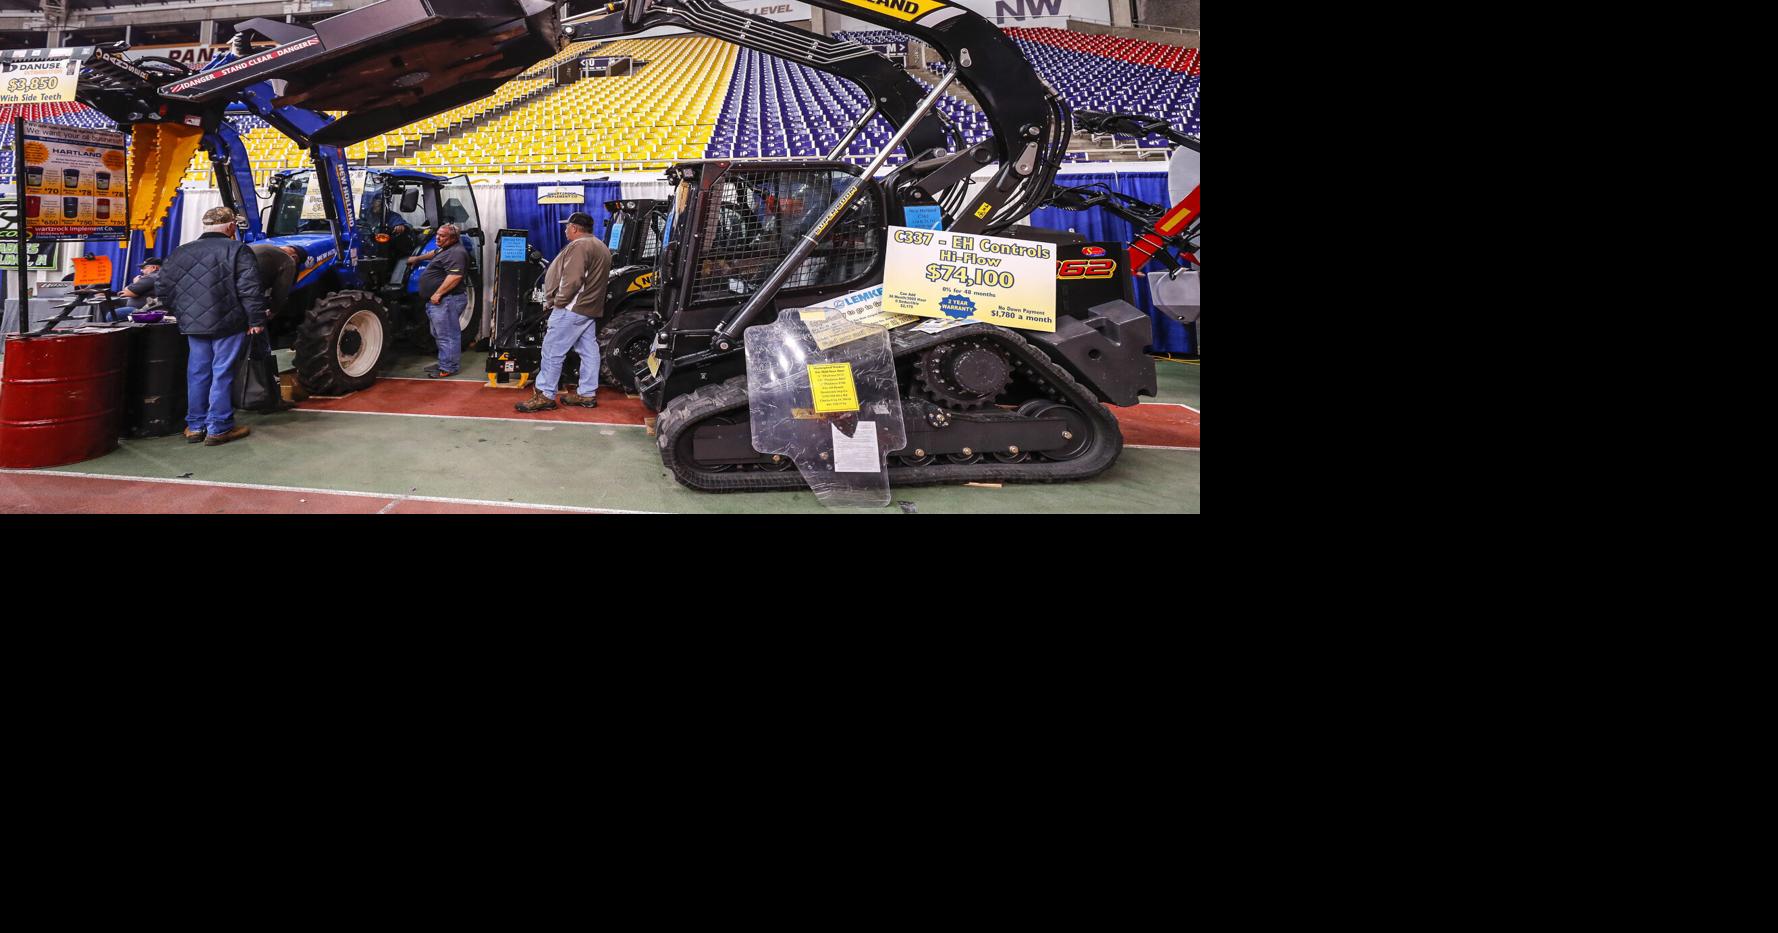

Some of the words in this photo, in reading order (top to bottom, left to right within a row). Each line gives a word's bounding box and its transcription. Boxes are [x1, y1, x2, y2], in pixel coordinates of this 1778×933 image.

[754, 4, 793, 15] LEVEL
[996, 0, 1061, 24] NW
[184, 73, 216, 89] DANGER
[221, 61, 248, 76] STAND
[249, 52, 273, 67] CLEAR
[277, 40, 311, 57] DANGER
[8, 76, 59, 92] $3,850
[0, 94, 19, 102] With
[21, 93, 38, 102] Side
[41, 92, 62, 101] Teeth
[64, 132, 80, 140] your
[53, 148, 103, 158] HARTLAND
[338, 163, 350, 185] NEW
[342, 186, 355, 228] HOLLAND
[894, 230, 935, 246] C337
[952, 235, 975, 250] EH
[980, 239, 1051, 259] Controls
[940, 250, 1002, 268] Hi-Flow
[926, 263, 1015, 288] $74,100
[1056, 258, 1117, 279] 62
[941, 303, 973, 312] WARRANTY
[1023, 307, 1045, 316] Payment
[1026, 315, 1053, 323] month
